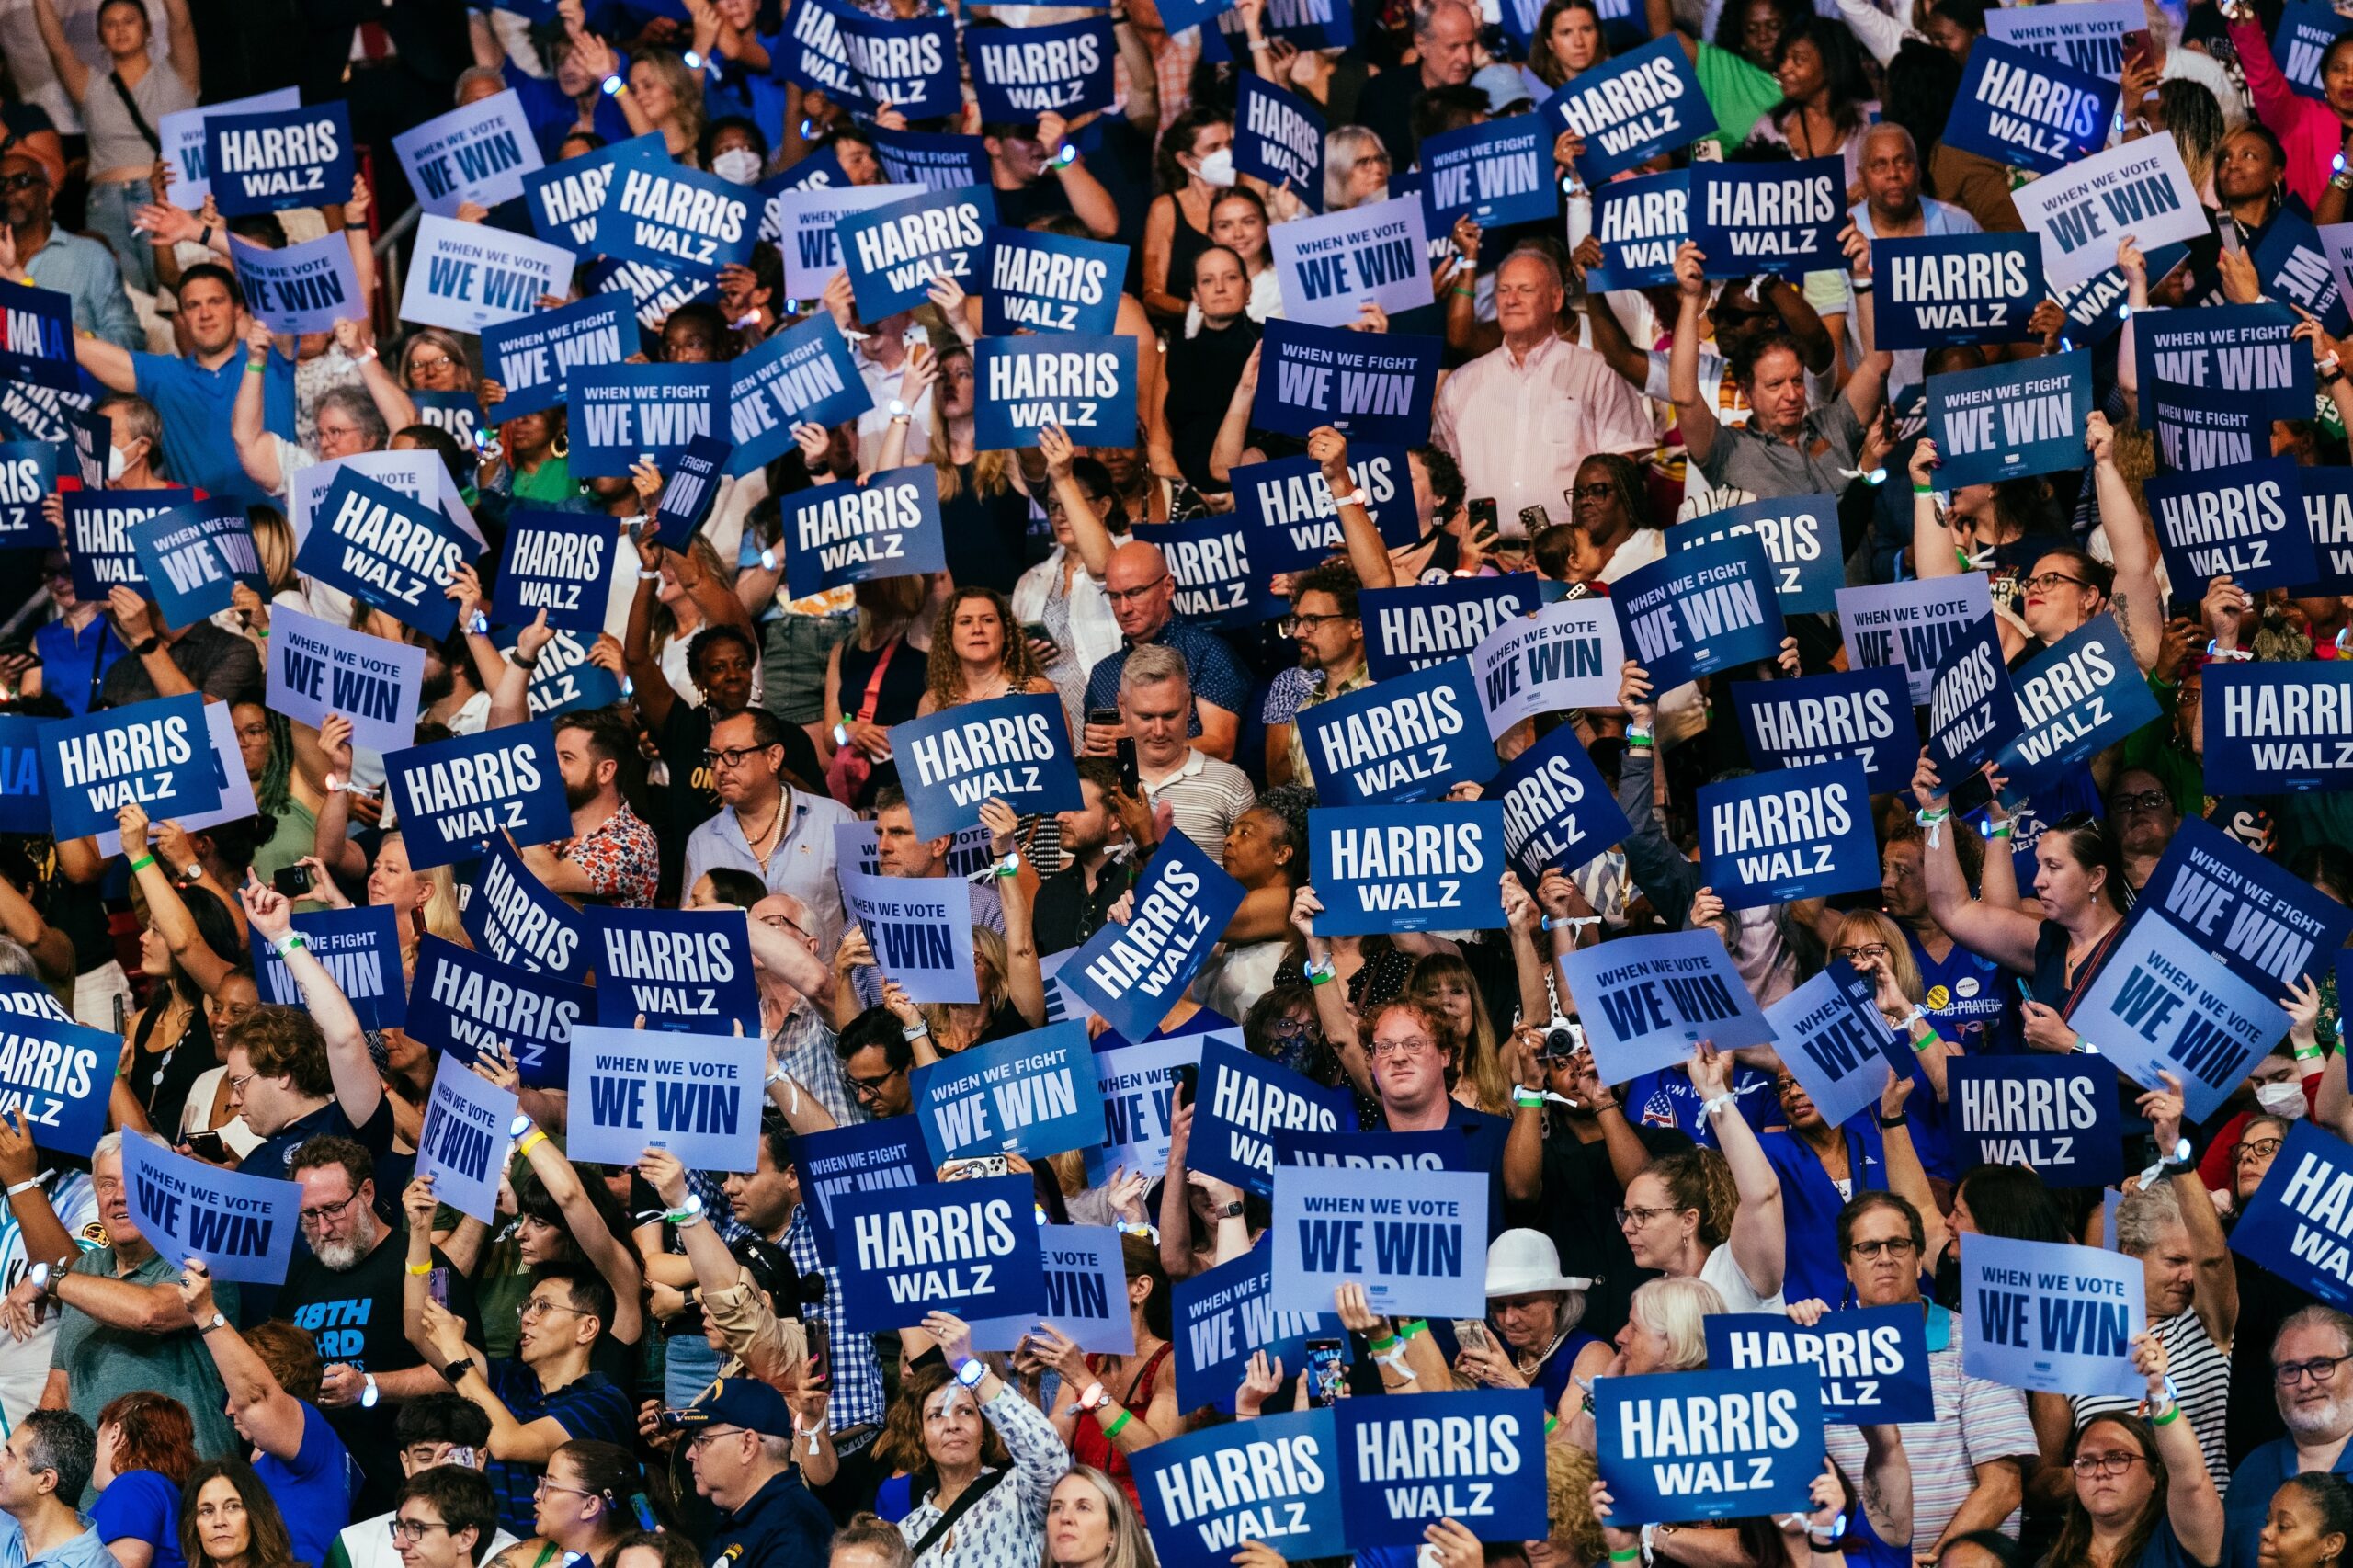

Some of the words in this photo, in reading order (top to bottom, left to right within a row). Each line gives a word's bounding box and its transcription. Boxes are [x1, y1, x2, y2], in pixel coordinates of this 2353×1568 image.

[2010, 24, 2054, 39] WHEN
[2060, 24, 2083, 36] WE
[2086, 20, 2125, 34] VOTE
[981, 33, 1100, 85] HARRIS
[1006, 81, 1085, 109] WALZ
[1560, 56, 1684, 137] HARRIS
[1975, 57, 2099, 138] HARRIS
[220, 119, 339, 174] HARRIS
[414, 140, 444, 162] WHEN
[447, 130, 466, 146] WE
[469, 116, 506, 138] VOTE
[1248, 90, 1320, 168] HARRIS
[1433, 148, 1470, 166] WHEN
[1472, 142, 1493, 156] WE
[1495, 134, 1536, 153] FIGHT
[1599, 107, 1681, 156] WALZ
[417, 159, 454, 200] WE
[454, 131, 524, 184] WIN
[910, 150, 926, 163] WE
[929, 152, 969, 165] FIGHT
[243, 168, 324, 198] WALZ
[1707, 176, 1835, 226] HARRIS
[2042, 182, 2089, 212] WHEN
[2092, 172, 2118, 190] WE
[2120, 157, 2161, 178] VOTE
[635, 222, 719, 266] WALZ
[855, 203, 983, 274] HARRIS
[1296, 237, 1343, 256] WHEN
[1347, 229, 1370, 244] WE
[1373, 222, 1407, 238] VOTE
[1729, 229, 1818, 256] WALZ
[267, 263, 290, 277] WE
[291, 256, 330, 277] VOTE
[275, 270, 344, 312] WIN
[1004, 296, 1080, 331] WALZ
[1282, 343, 1332, 363] WHEN
[1336, 353, 1363, 367] WE
[1367, 357, 1418, 369] FIGHT
[2154, 333, 2205, 347] WHEN
[2210, 330, 2236, 343] WE
[2241, 325, 2290, 340] FIGHT
[769, 353, 845, 417] WIN
[989, 352, 1120, 401] HARRIS
[2218, 344, 2292, 390] WIN
[585, 387, 630, 401] WHEN
[634, 386, 658, 399] WE
[663, 385, 710, 399] FIGHT
[1010, 402, 1097, 428] WALZ
[1945, 390, 1992, 408] WHEN
[1996, 385, 2020, 399] WE
[2025, 375, 2072, 394] FIGHT
[686, 457, 713, 473] FIGHT
[153, 528, 199, 551] WHEN
[200, 518, 224, 534] WE
[226, 516, 246, 529] FIGHT
[797, 483, 921, 551] HARRIS
[160, 541, 222, 595] WE
[212, 533, 258, 574] WIN
[510, 529, 604, 582] HARRIS
[820, 533, 904, 572] WALZ
[2188, 540, 2271, 577] WALZ
[520, 581, 582, 610] WALZ
[1627, 587, 1666, 614] WHEN
[1668, 576, 1695, 596] WE
[1699, 561, 1747, 586] FIGHT
[1854, 610, 1891, 627] WHEN
[1894, 607, 1920, 621] WE
[1925, 600, 1968, 618] VOTE
[1486, 637, 1520, 667] WHEN
[1524, 626, 1548, 644] WE
[1552, 621, 1597, 634] VOTE
[283, 647, 324, 702] WE
[332, 665, 401, 723] WIN
[58, 716, 191, 788] HARRIS
[911, 713, 1054, 787] HARRIS
[1318, 686, 1463, 774] HARRIS
[1942, 702, 1996, 760] WALZ
[2017, 696, 2112, 766] WALZ
[88, 772, 176, 812] WALZ
[404, 744, 541, 816] HARRIS
[949, 767, 1042, 807] WALZ
[1354, 744, 1453, 798] WALZ
[1331, 822, 1483, 881] HARRIS
[1737, 845, 1835, 885] WALZ
[483, 853, 579, 971] HARRIS
[1358, 881, 1461, 912] WALZ
[2188, 847, 2241, 887] WHEN
[2244, 879, 2272, 906] WE
[2275, 899, 2325, 937] FIGHT
[332, 932, 377, 948] FIGHT
[883, 922, 955, 970] WIN
[1085, 858, 1200, 999] HARRIS
[2164, 863, 2225, 936] WE
[2223, 893, 2314, 983] WIN
[1139, 905, 1211, 997] WALZ
[1596, 965, 1650, 989] WHEN
[1652, 959, 1672, 974] WE
[1673, 955, 1712, 971] VOTE
[1599, 981, 1672, 1042] WE
[1661, 974, 1741, 1024] WIN
[1794, 994, 1847, 1037] WHEN
[2146, 949, 2197, 996] WHEN
[2199, 983, 2227, 1017] WE
[2228, 1012, 2263, 1044] VOTE
[596, 1055, 649, 1072] WHEN
[654, 1059, 683, 1074] WE
[689, 1062, 738, 1078] VOTE
[932, 1078, 979, 1101] WHEN
[983, 1065, 1011, 1083] WE
[1015, 1049, 1067, 1074] FIGHT
[438, 1081, 451, 1100] WHEN
[453, 1091, 466, 1108] WE
[468, 1104, 495, 1128] VOTE
[809, 1156, 844, 1176] WHEN
[847, 1148, 867, 1167] WE
[870, 1143, 907, 1162] FIGHT
[1980, 1137, 2075, 1166] WALZ
[140, 1160, 186, 1188] WHEN
[190, 1185, 219, 1204] WE
[224, 1195, 273, 1214] VOTE
[1304, 1196, 1362, 1213] WHEN
[1371, 1198, 1402, 1214] WE
[1408, 1200, 1459, 1217] VOTE
[136, 1174, 178, 1237] WE
[189, 1203, 272, 1257] WIN
[1051, 1252, 1098, 1267] VOTE
[1299, 1219, 1362, 1274] WE
[1373, 1221, 1462, 1278] WIN
[887, 1265, 995, 1304] WALZ
[1982, 1266, 2031, 1287] WHEN
[2037, 1272, 2068, 1290] WE
[2075, 1277, 2124, 1297] VOTE
[293, 1298, 372, 1330] 18TH
[1978, 1288, 2029, 1347] WE
[2040, 1296, 2129, 1358] WIN
[1620, 1388, 1800, 1460] HARRIS
[1356, 1415, 1521, 1483] HARRIS
[1154, 1435, 1325, 1527] HARRIS
[1654, 1457, 1774, 1496] WALZ
[1385, 1483, 1494, 1519] WALZ
[1198, 1502, 1311, 1553] WALZ
